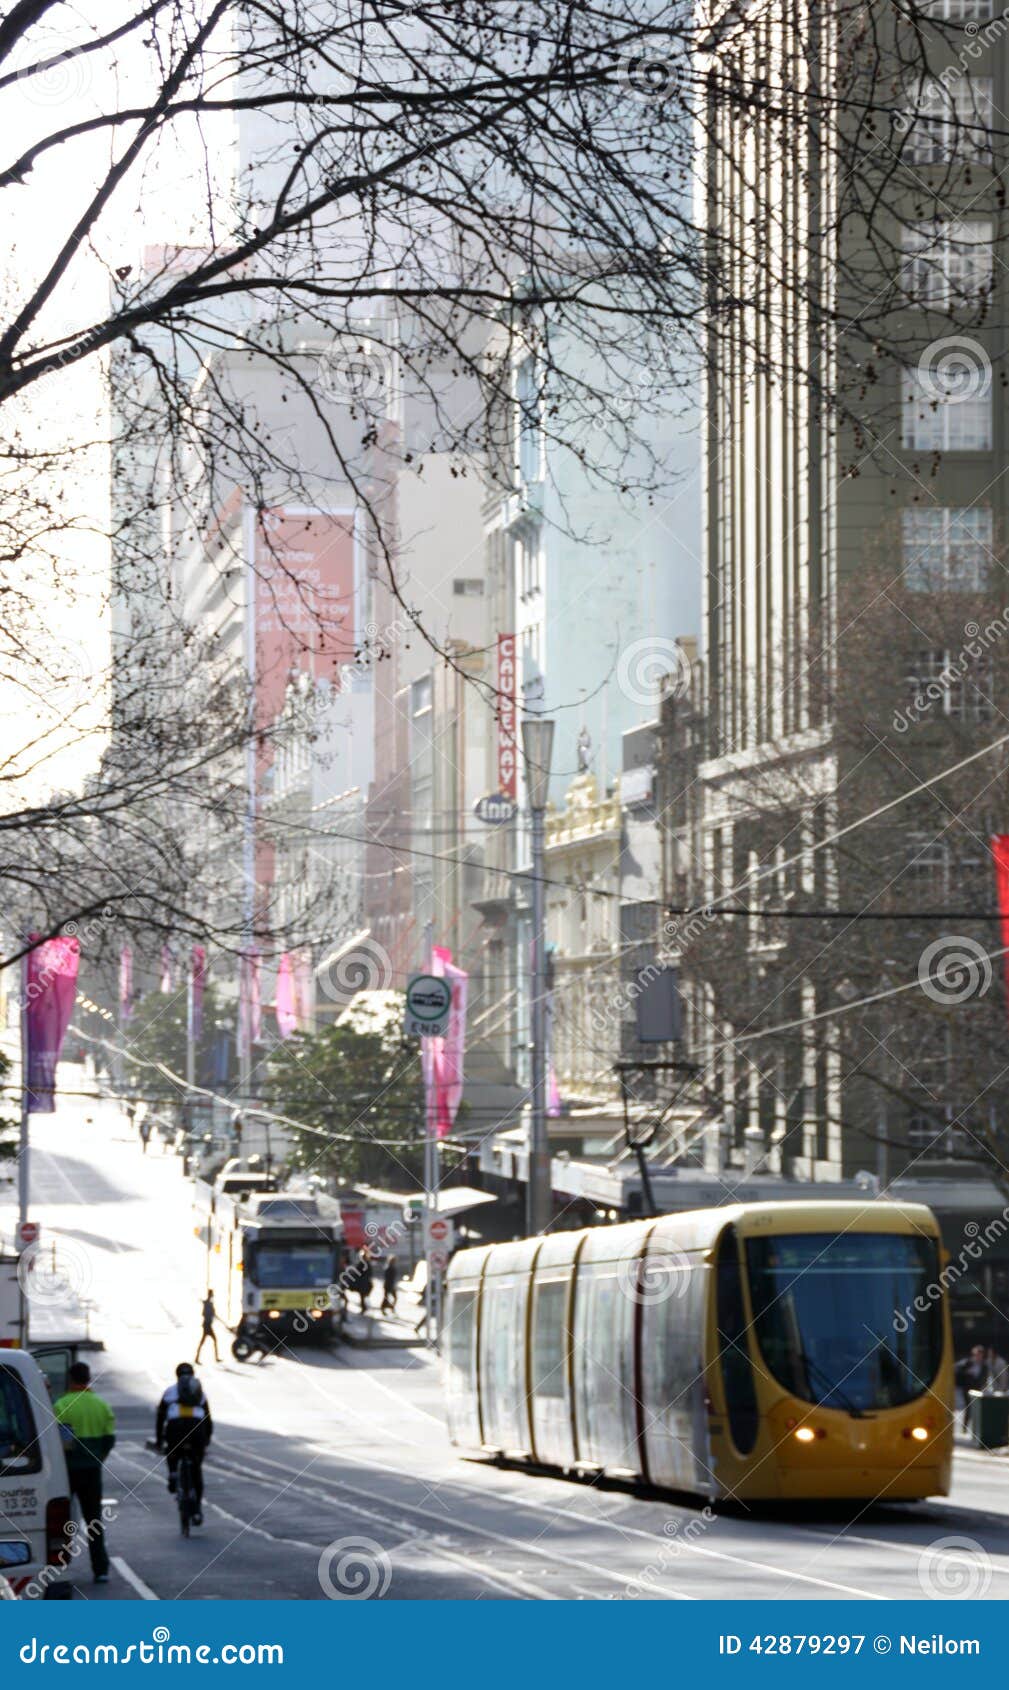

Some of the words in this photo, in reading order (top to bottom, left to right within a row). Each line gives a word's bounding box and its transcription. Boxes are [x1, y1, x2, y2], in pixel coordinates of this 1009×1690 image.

[499, 639, 516, 785] CAUSEWAY
[410, 1022, 441, 1034] END
[0, 1487, 36, 1498] ourier
